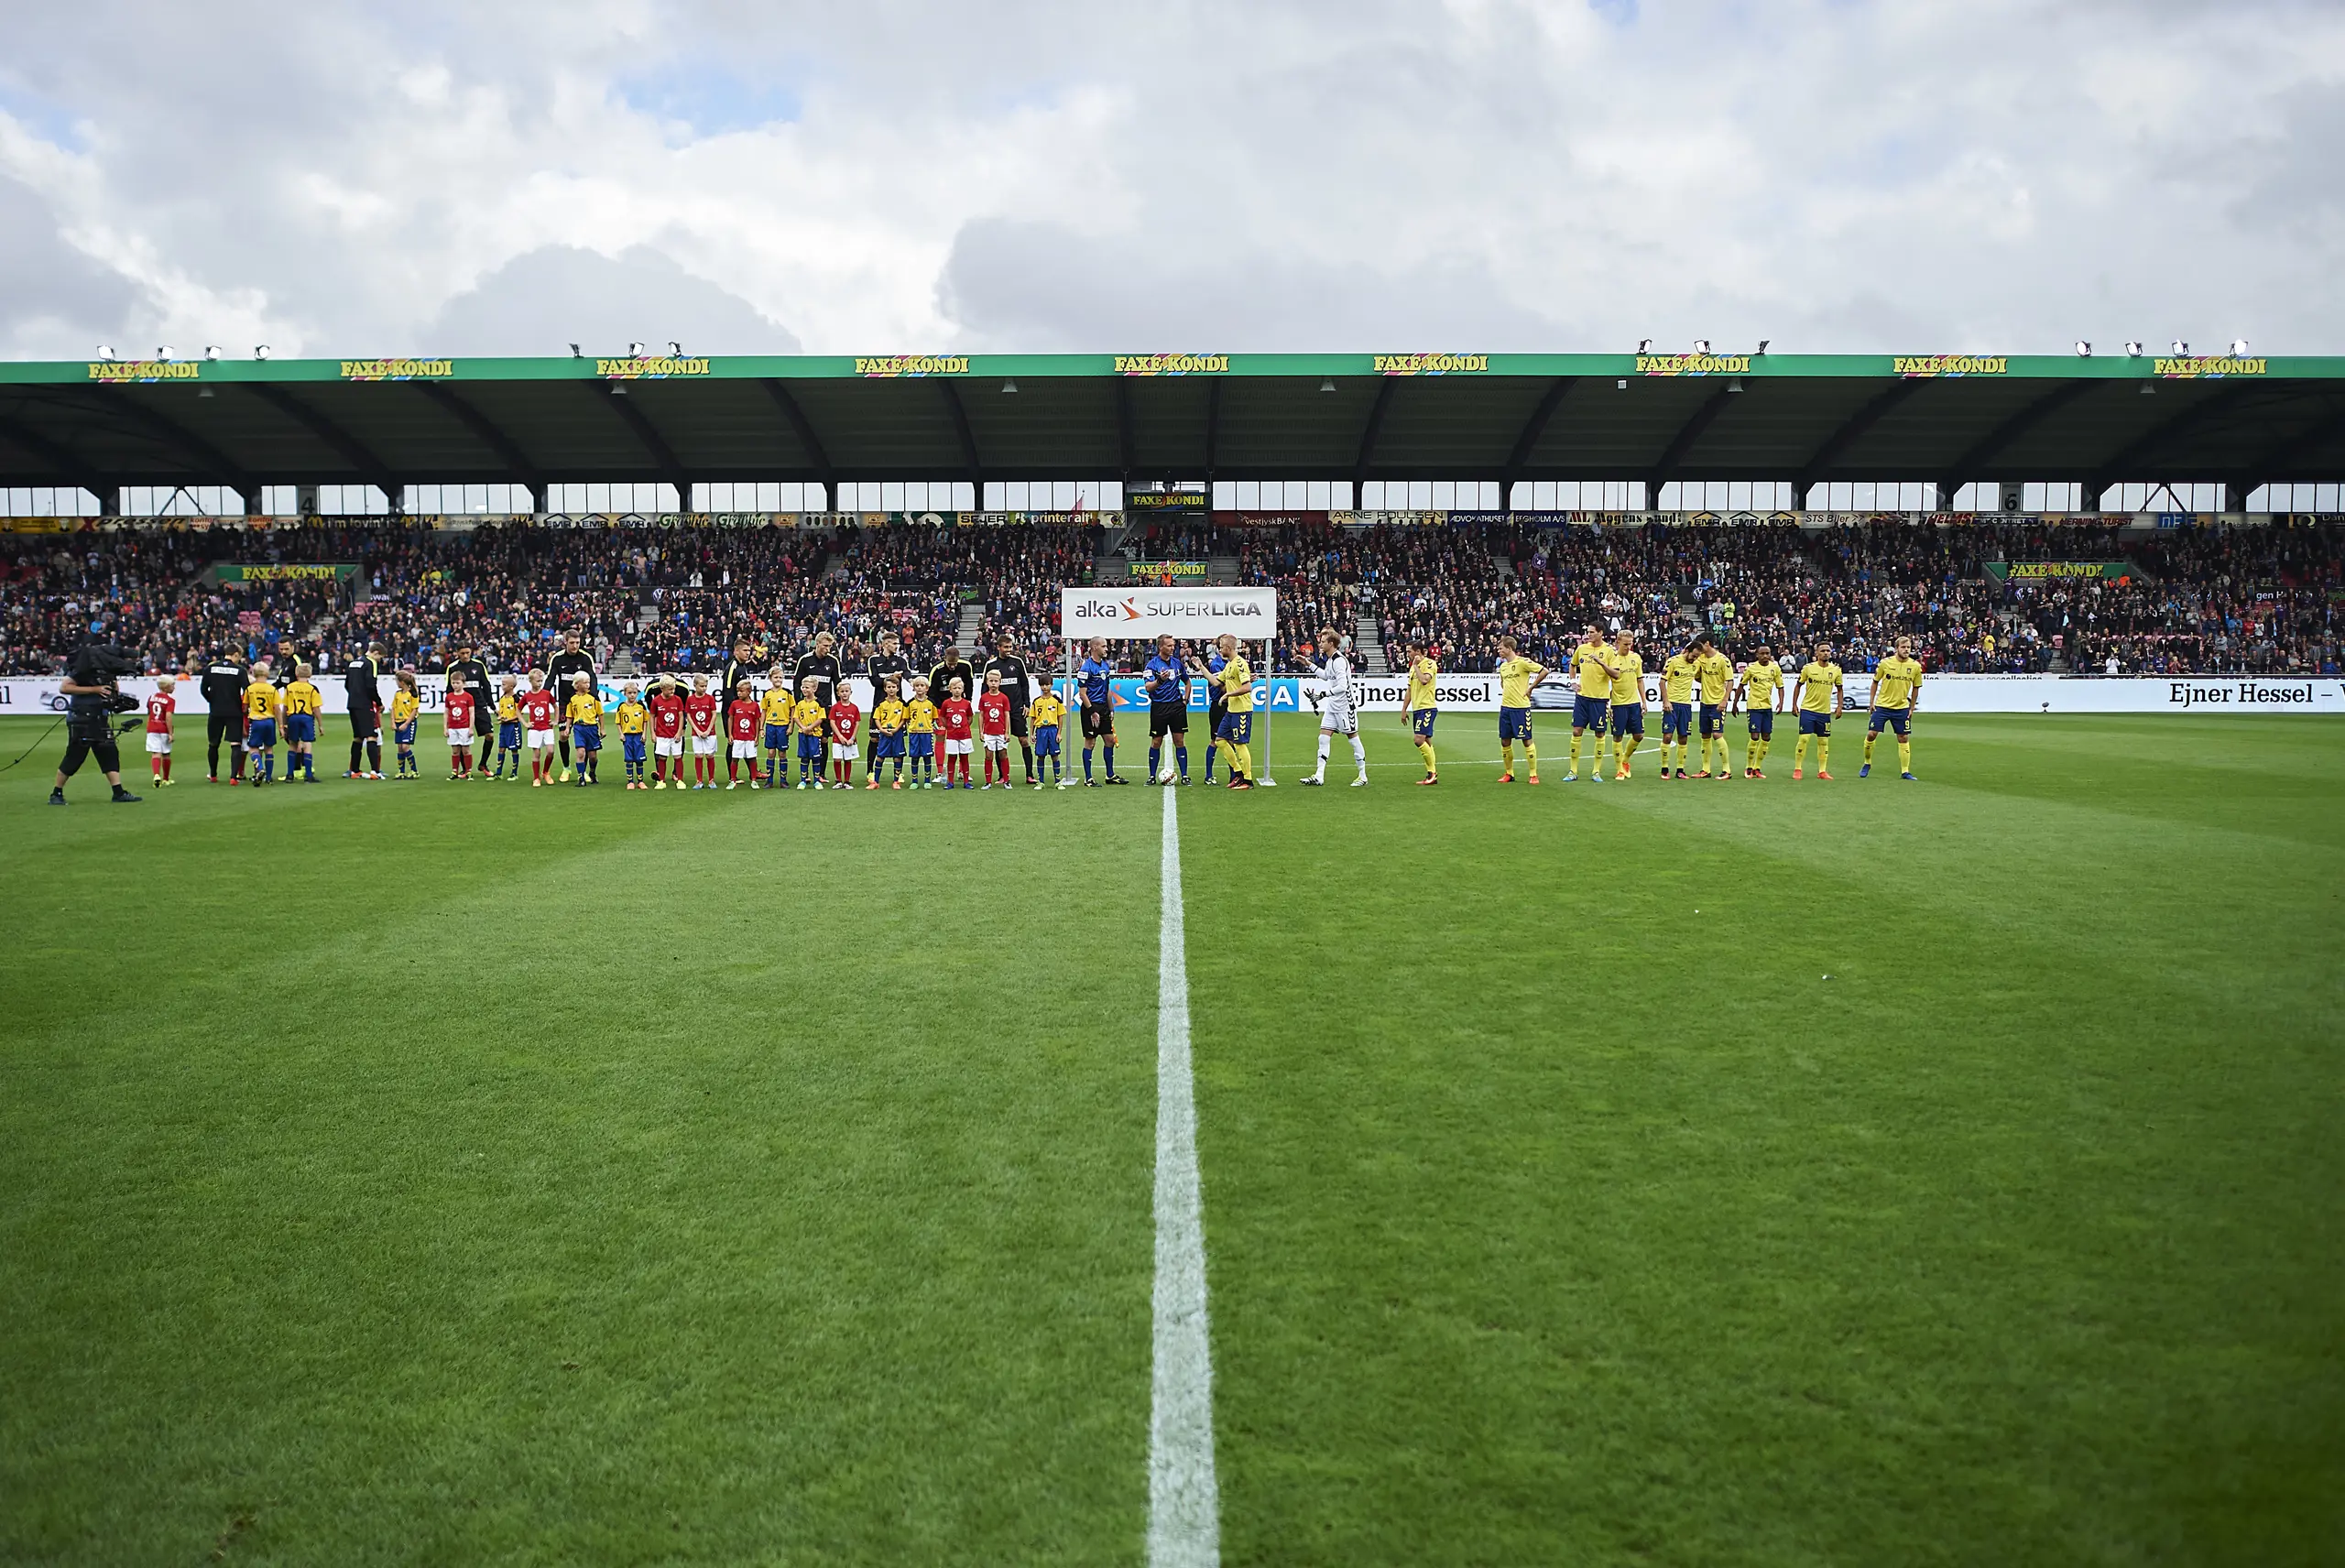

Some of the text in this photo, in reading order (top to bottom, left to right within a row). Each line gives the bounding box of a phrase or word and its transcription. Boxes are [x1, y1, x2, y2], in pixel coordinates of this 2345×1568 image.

[88, 363, 199, 378] FAXE KONDI
[341, 361, 453, 376] FAXE KONDI
[596, 359, 710, 375] FAXE KONDI
[856, 358, 969, 373] FAXE KONDI
[1115, 356, 1228, 372] FAXE KONDI
[1374, 356, 1488, 371] FAXE KONDI
[1636, 357, 1750, 372] FAXE KONDI
[1893, 358, 2007, 373] FAXE KONDI
[2154, 359, 2266, 374] FAXE KONDI
[1133, 495, 1205, 506] FAXE KONDI
[1031, 513, 1072, 524] printer
[1333, 511, 1444, 519] ARNE POULSEN
[1552, 515, 1565, 523] A/S
[1805, 514, 1849, 523] STS Biler
[1131, 565, 1206, 575] FAXE KONDI
[2009, 564, 2049, 578] FAXE
[1147, 602, 1261, 616] SUPERLIGA
[2169, 683, 2313, 708] Ejner Hessel
[152, 702, 162, 720] 9
[256, 697, 267, 713] 3
[1598, 716, 1603, 725] 4
[1904, 720, 1910, 729] 9
[1518, 725, 1524, 735] 2
